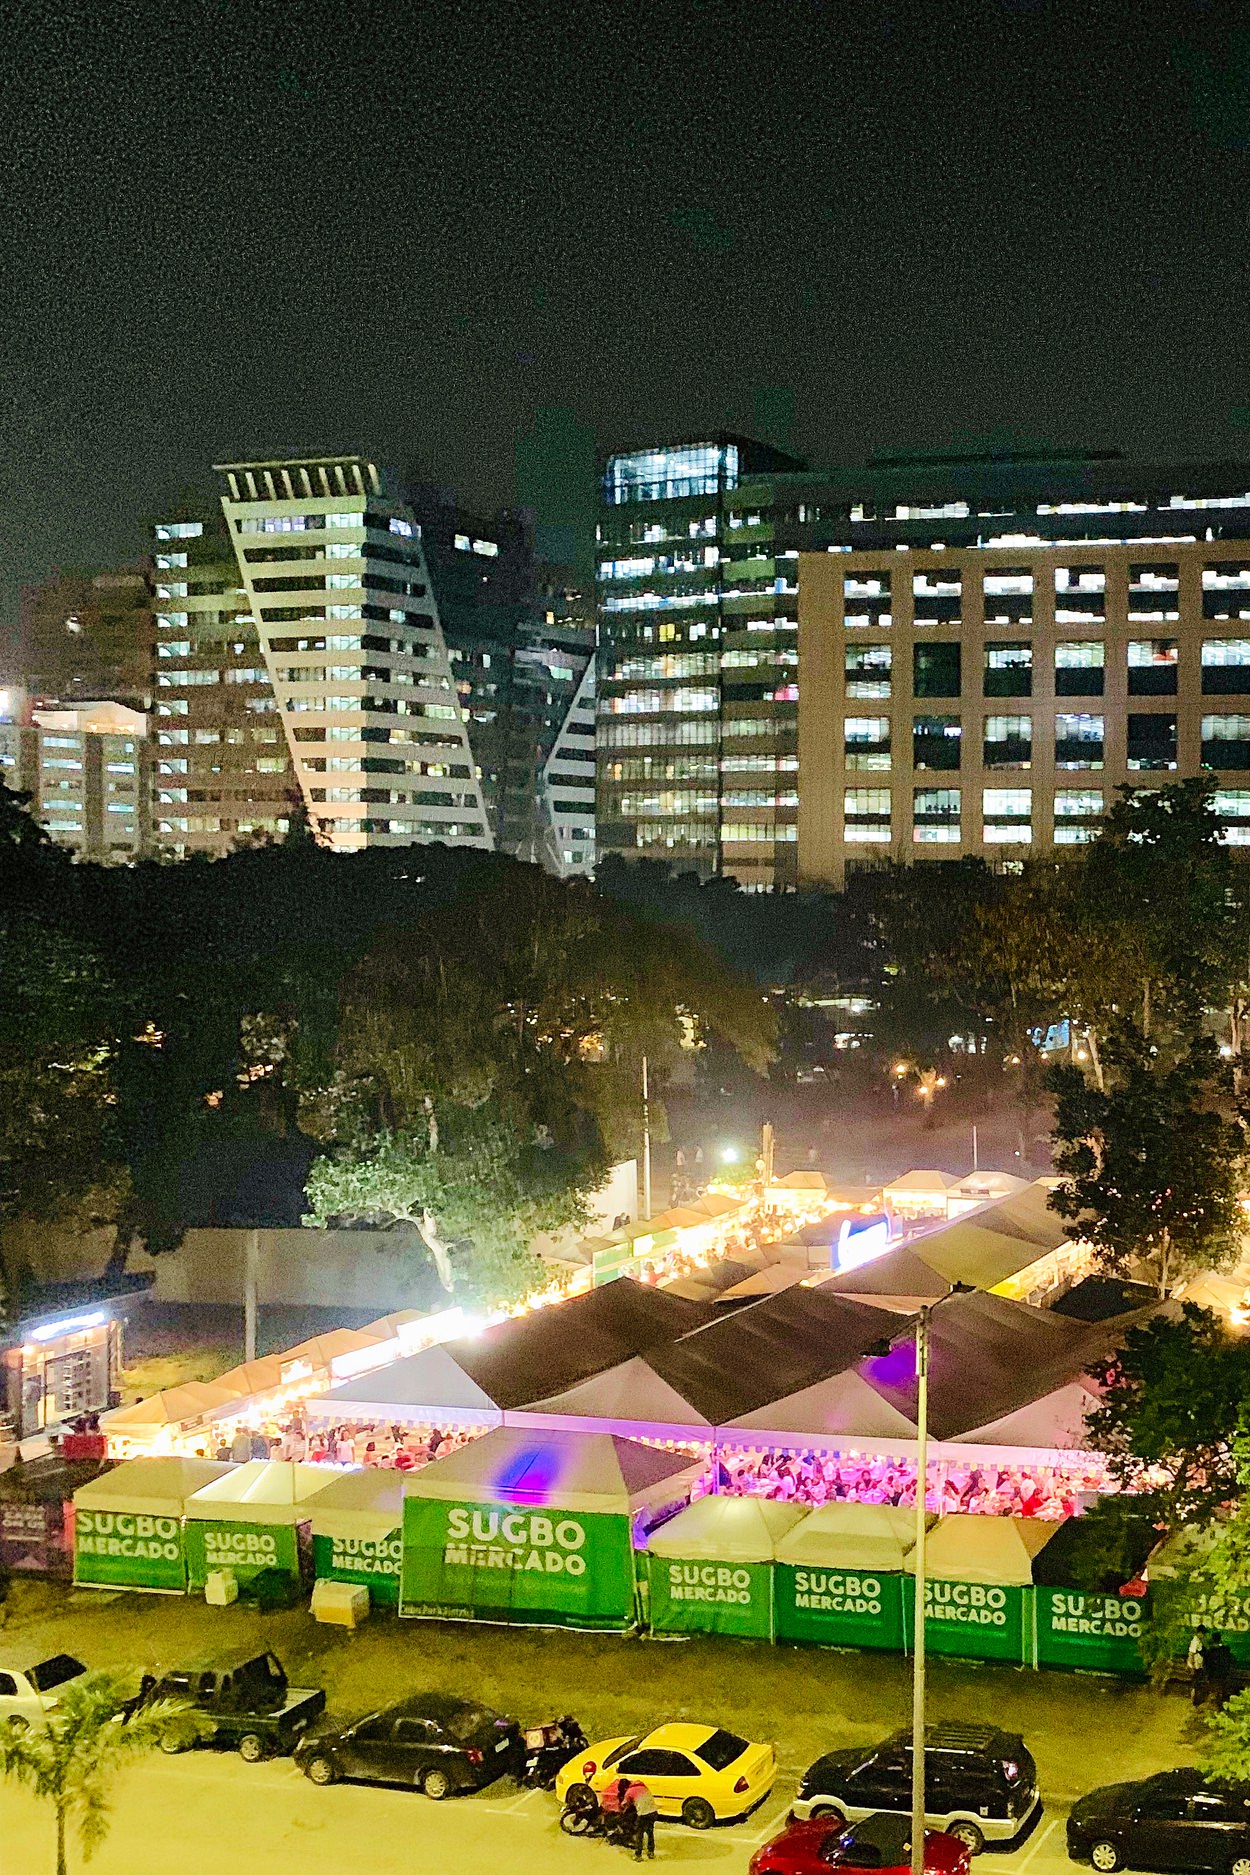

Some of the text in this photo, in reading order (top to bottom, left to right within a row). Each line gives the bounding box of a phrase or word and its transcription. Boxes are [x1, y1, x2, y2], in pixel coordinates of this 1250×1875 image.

[76, 1511, 178, 1540] SUGBO
[445, 1508, 586, 1550] SUGBO
[78, 1535, 180, 1561] MERCADO
[204, 1532, 276, 1552] SUGBO
[332, 1538, 403, 1559] SUGBO
[205, 1550, 278, 1566] MERCADO
[445, 1542, 587, 1576] MERCADO
[668, 1564, 751, 1589] SUGBO
[794, 1571, 882, 1598] SUGBO
[669, 1585, 751, 1605] MERCADO
[795, 1593, 882, 1615] MERCADO
[1051, 1616, 1143, 1638] MERCADO
